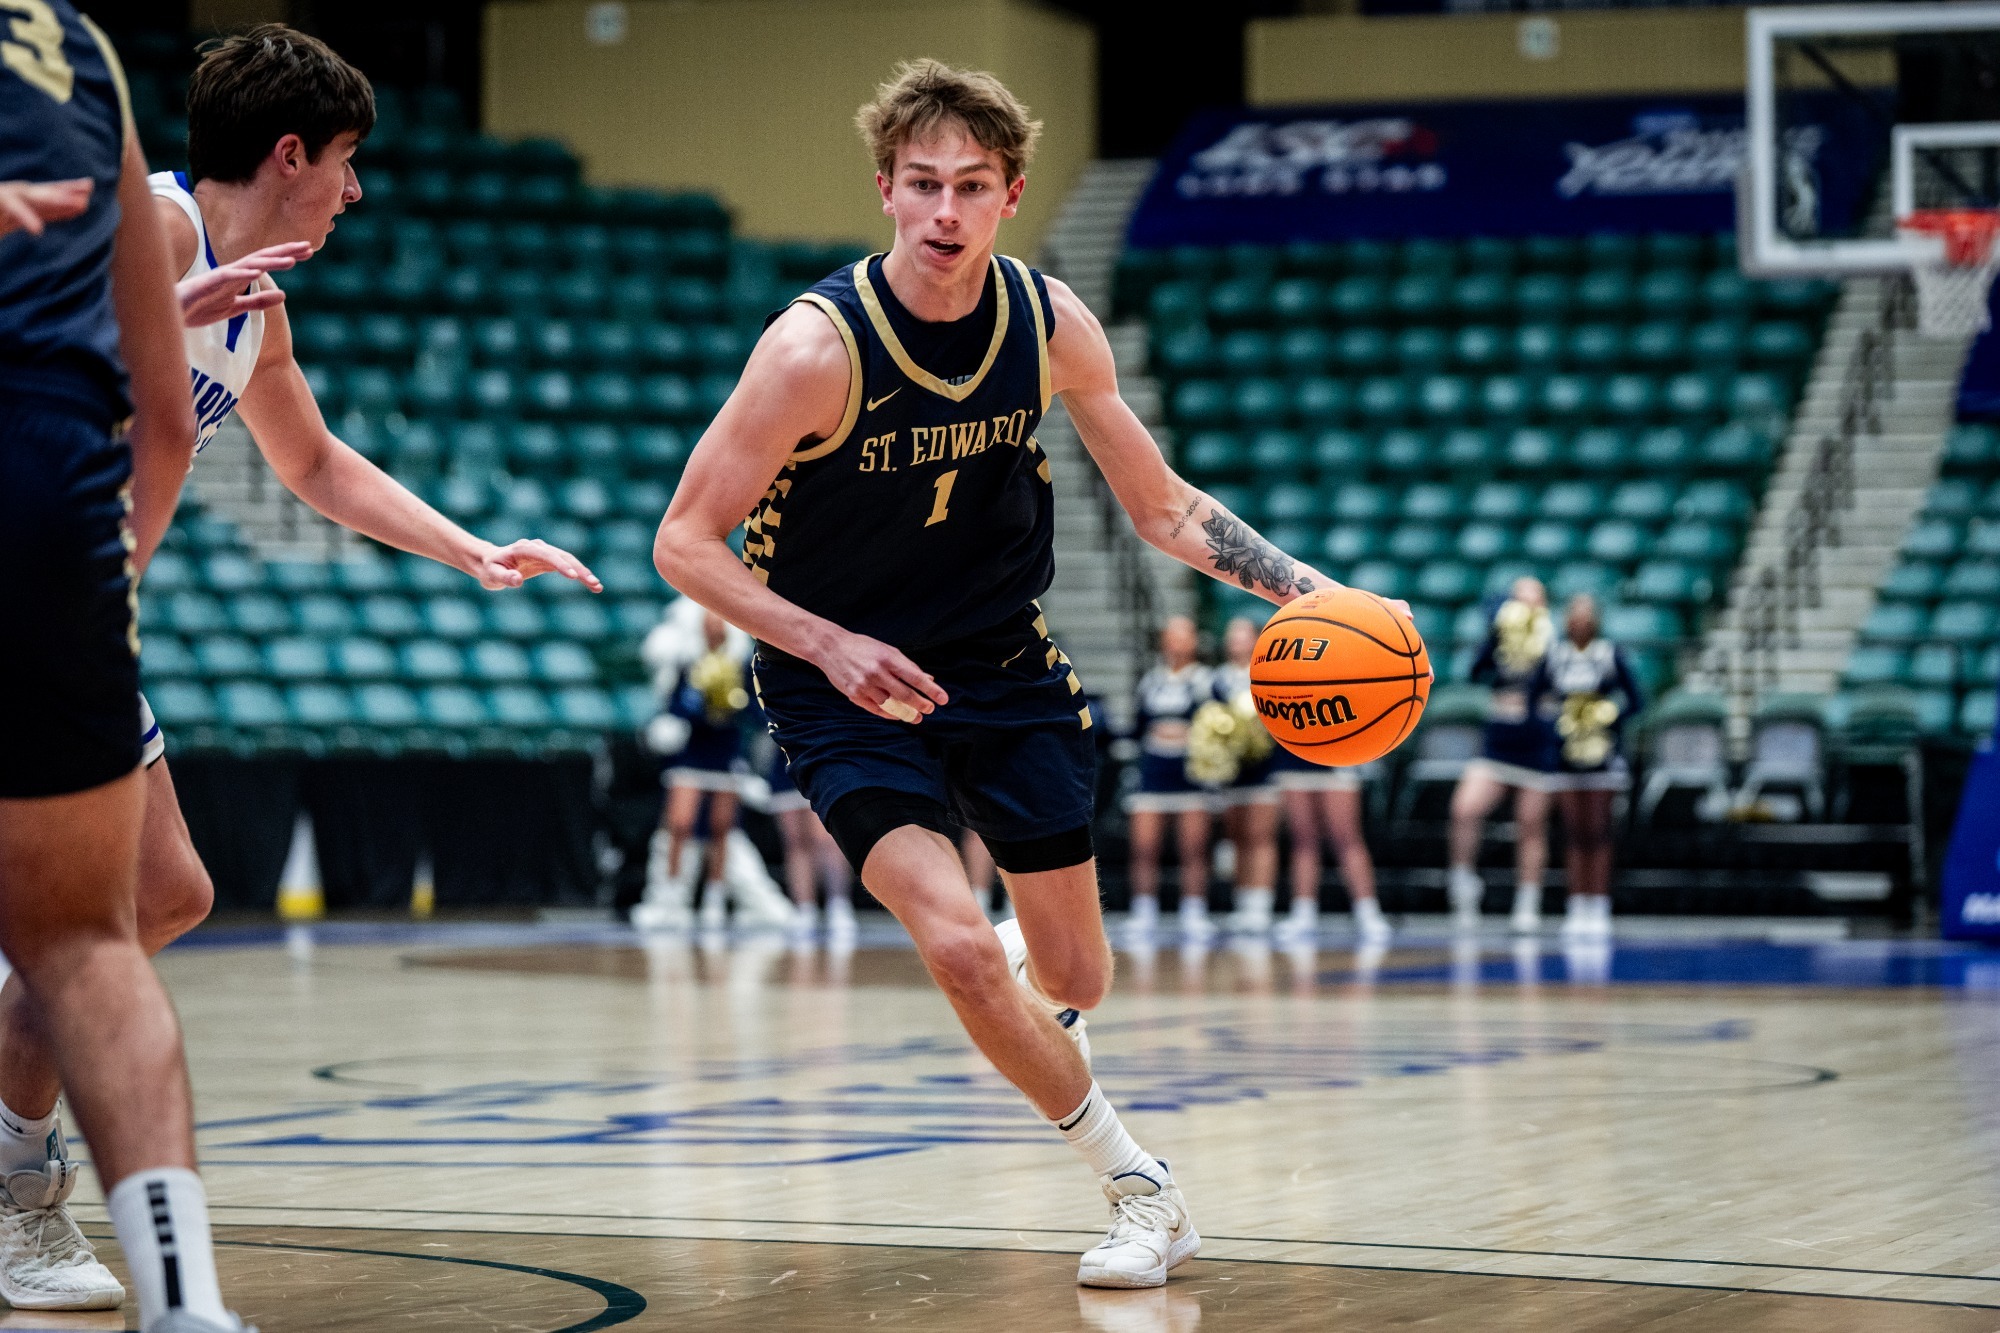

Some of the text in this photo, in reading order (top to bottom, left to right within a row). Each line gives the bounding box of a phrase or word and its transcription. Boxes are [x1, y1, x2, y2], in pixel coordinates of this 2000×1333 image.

[0, 0, 74, 103] 3
[859, 431, 898, 472] ST.
[924, 469, 959, 528] 1
[1266, 637, 1331, 662] EVO
[1252, 694, 1358, 730] Wilson
